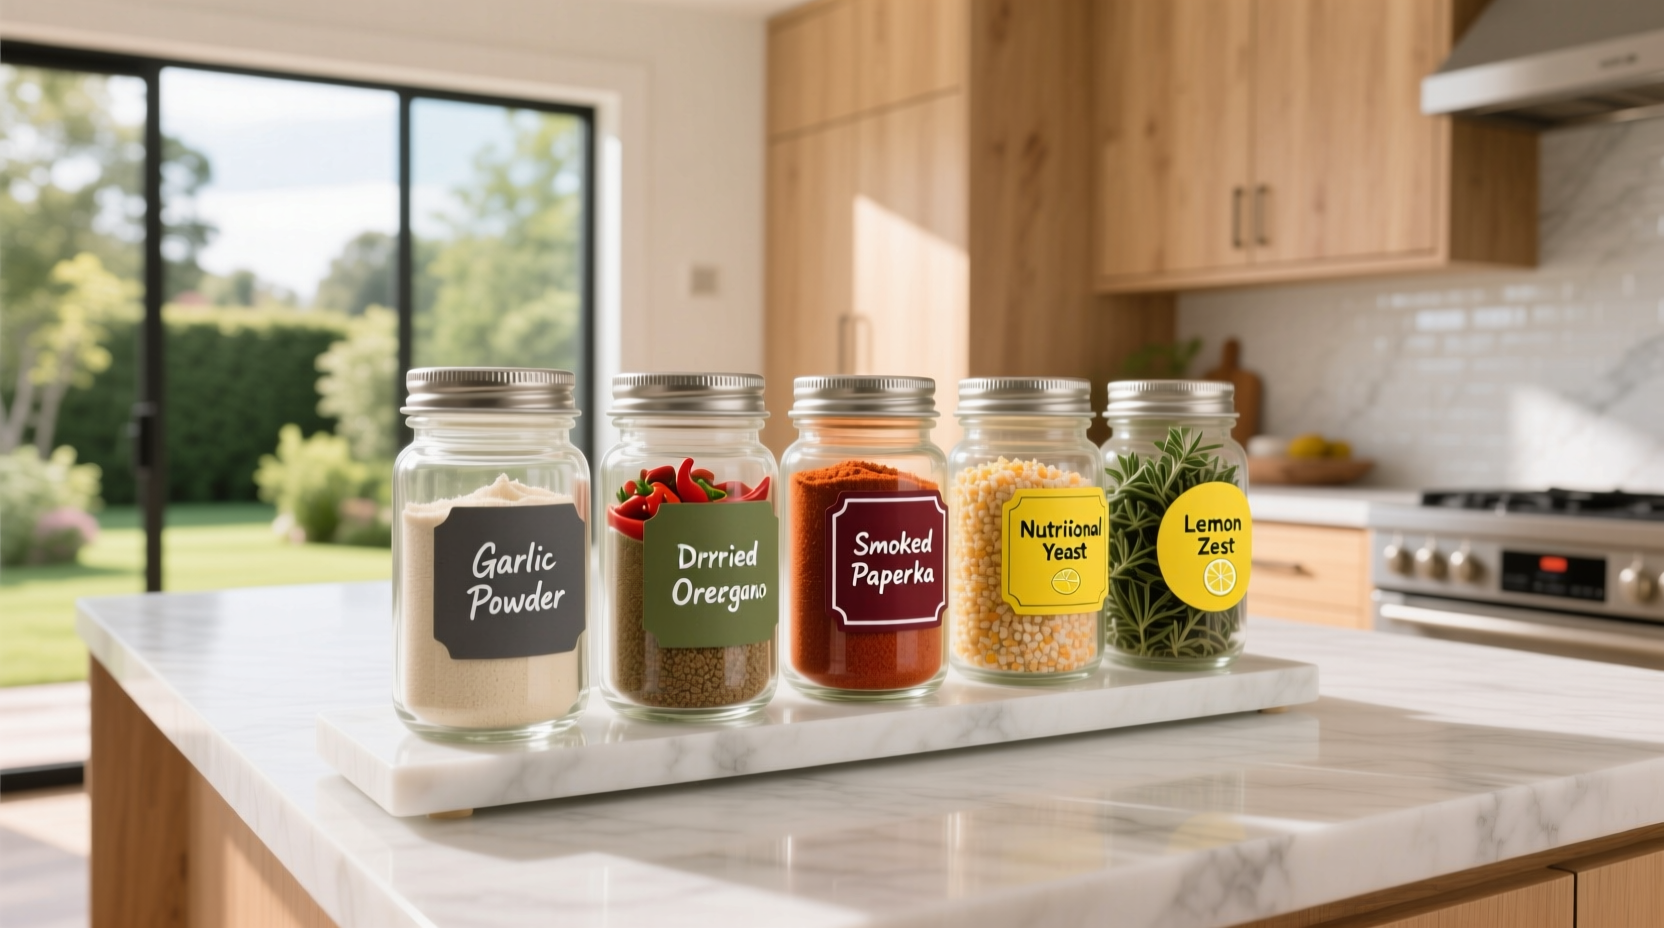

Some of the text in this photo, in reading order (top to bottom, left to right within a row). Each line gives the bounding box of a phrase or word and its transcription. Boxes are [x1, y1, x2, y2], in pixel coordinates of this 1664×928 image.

[1184, 514, 1242, 533] Lemon
[853, 527, 933, 556] Smoked
[1042, 542, 1088, 561] Yeast
[1197, 536, 1236, 556] Zest
[473, 541, 557, 579] Garlic
[851, 560, 936, 595] Paperka
[467, 579, 566, 621] Powder
